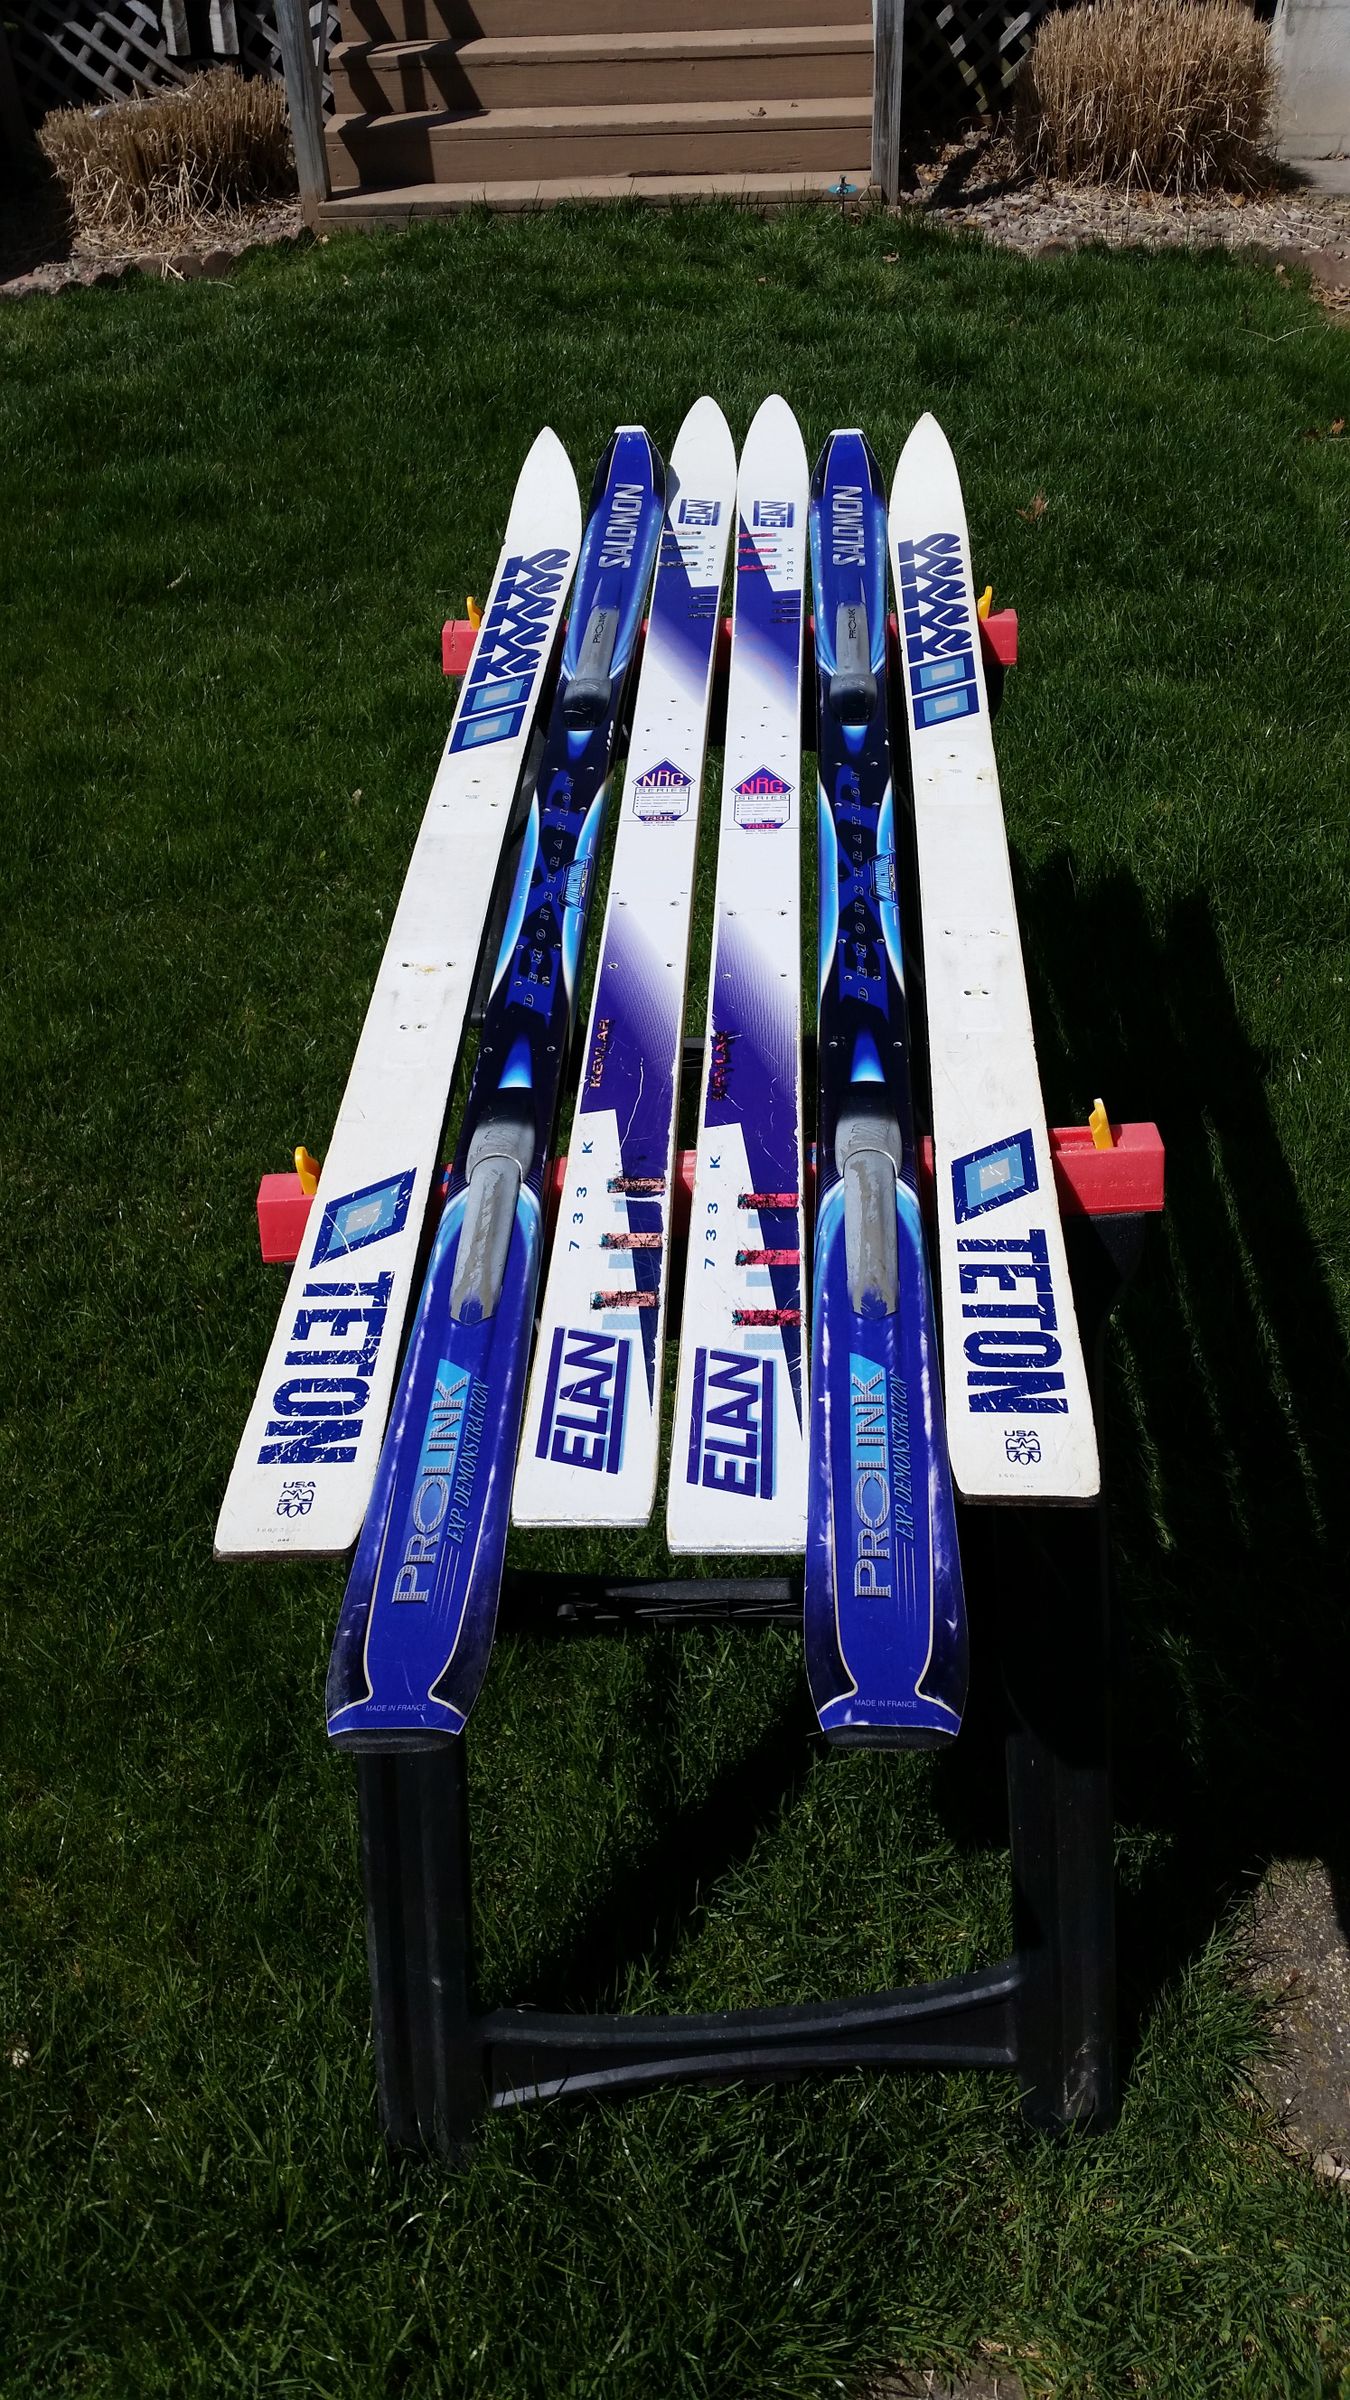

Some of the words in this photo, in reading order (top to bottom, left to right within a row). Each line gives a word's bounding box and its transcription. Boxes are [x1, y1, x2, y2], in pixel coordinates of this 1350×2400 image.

[598, 483, 645, 569] SALOMON
[684, 499, 714, 526] ELAN
[760, 500, 787, 528] ELAN
[832, 485, 866, 567] SALOMON
[705, 557, 715, 577] 733
[786, 560, 794, 580] 733
[642, 769, 684, 787] NRG
[741, 777, 784, 796] NRG
[523, 776, 576, 1007] DEMONSTRATION
[850, 771, 869, 1001] DEMONSTRATION
[590, 1018, 610, 1088] KEVLAR
[568, 1186, 588, 1252] 733
[582, 1140, 594, 1154] K
[709, 1155, 721, 1168] K
[703, 1202, 718, 1269] 733
[956, 1228, 1070, 1414] TETON
[256, 1270, 396, 1465] TETON
[550, 1329, 618, 1472] ELAN
[452, 1377, 490, 1509] DEMONSTRATION
[702, 1350, 761, 1497] ELAN
[890, 1373, 914, 1506] DEMONSTRATION
[391, 1375, 468, 1604] PROLINK
[851, 1370, 892, 1598] PROLINK
[854, 1699, 876, 1707] MADE
[886, 1700, 918, 1708] FRANCE
